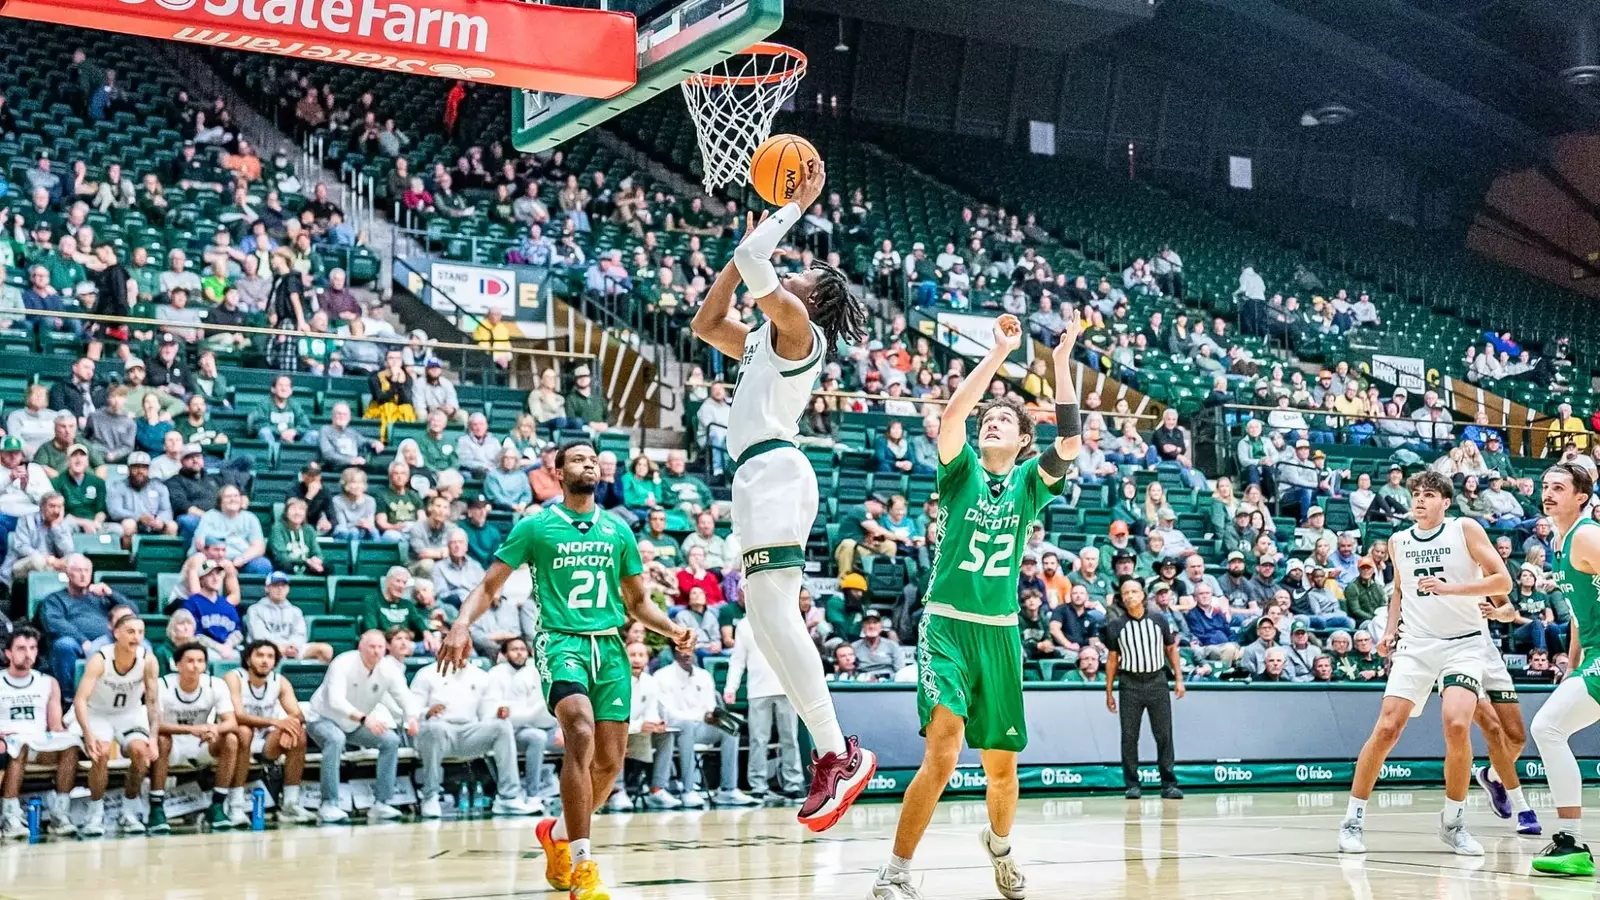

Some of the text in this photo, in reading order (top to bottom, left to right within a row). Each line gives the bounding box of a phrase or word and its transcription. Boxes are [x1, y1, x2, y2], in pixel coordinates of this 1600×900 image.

[783, 168, 797, 200] NCAA
[976, 494, 1016, 516] NORTH
[964, 508, 1021, 530] DAKOTA
[556, 541, 614, 555] NORTH
[958, 529, 1016, 577] 52
[1405, 547, 1451, 558] COLORADO
[553, 555, 615, 569] DAKOTA
[744, 551, 770, 568] AMS
[1414, 555, 1441, 564] STATE
[567, 570, 608, 609] 21
[1455, 674, 1480, 688] RAM
[1501, 691, 1518, 700] RA
